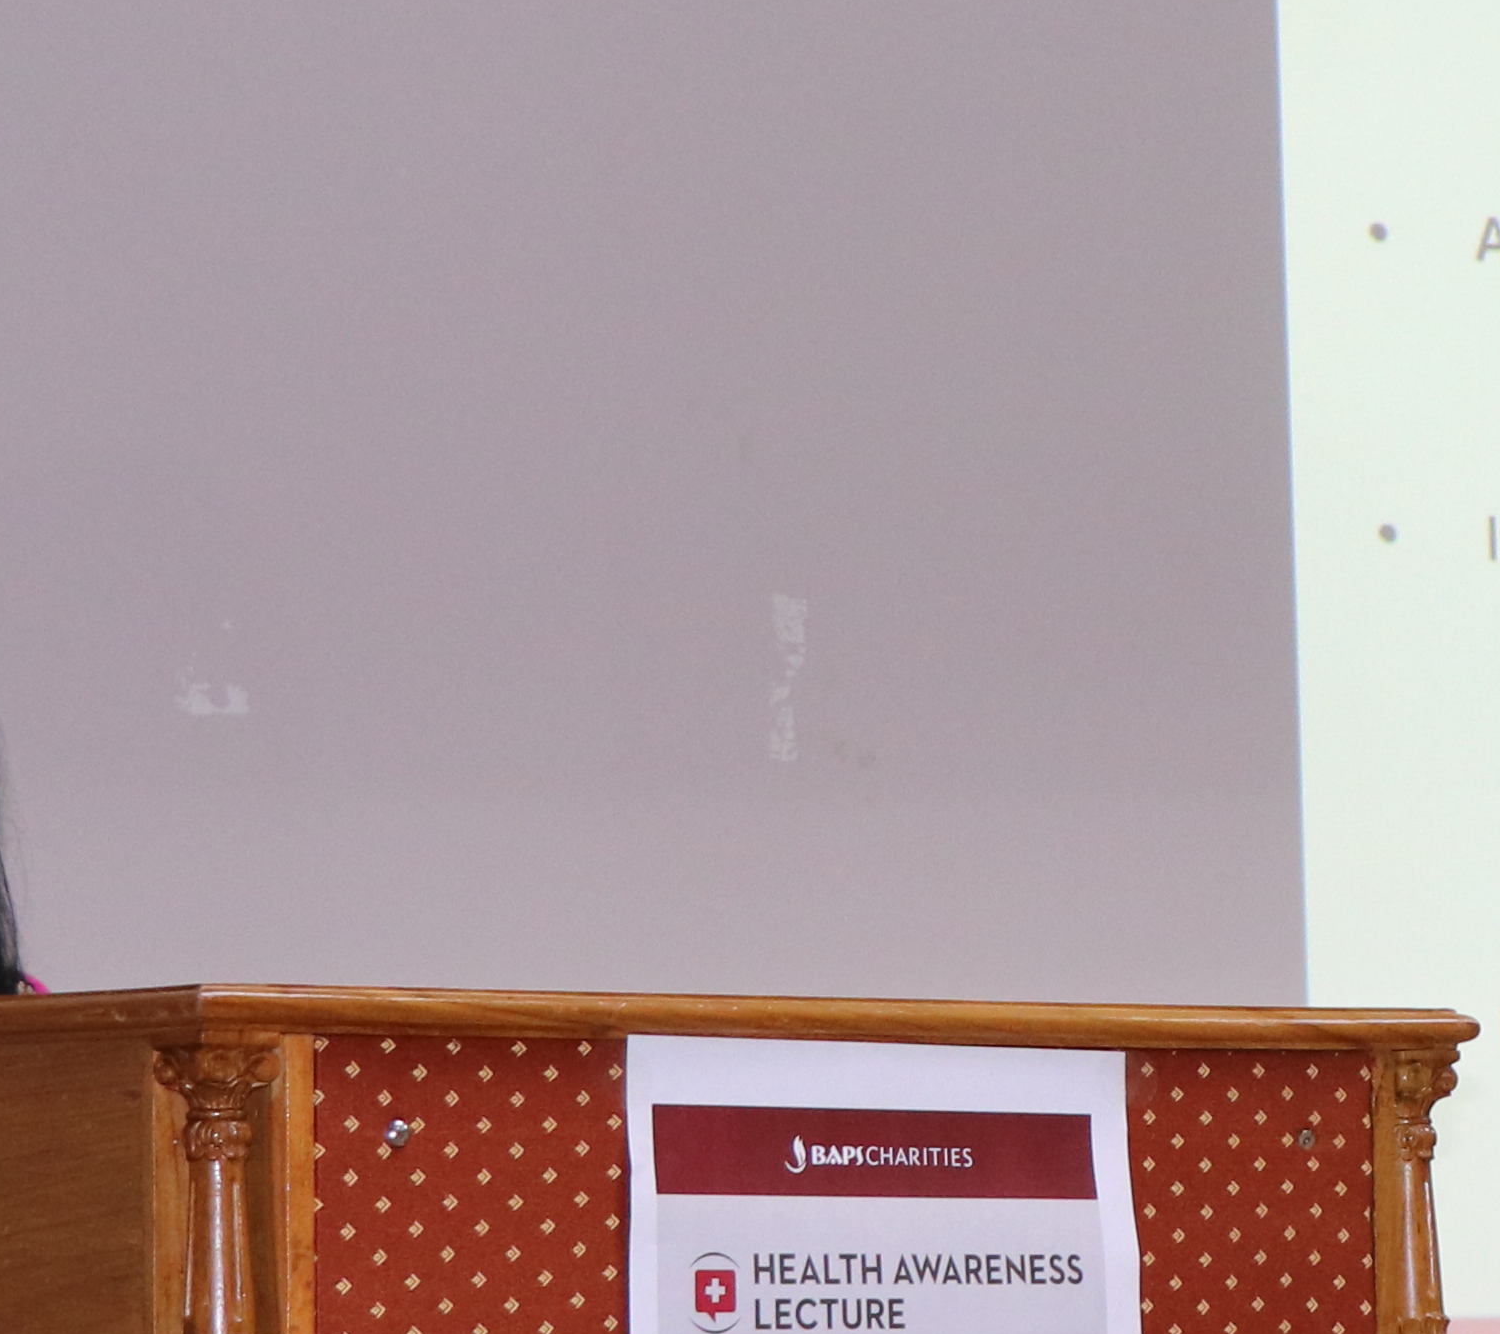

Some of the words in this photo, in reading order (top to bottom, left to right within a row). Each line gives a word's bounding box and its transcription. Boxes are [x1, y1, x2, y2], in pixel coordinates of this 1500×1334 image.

[754, 1254, 882, 1285] HEALTH
[894, 1254, 1083, 1285] AWARENESS
[755, 1298, 905, 1330] LECTURE
